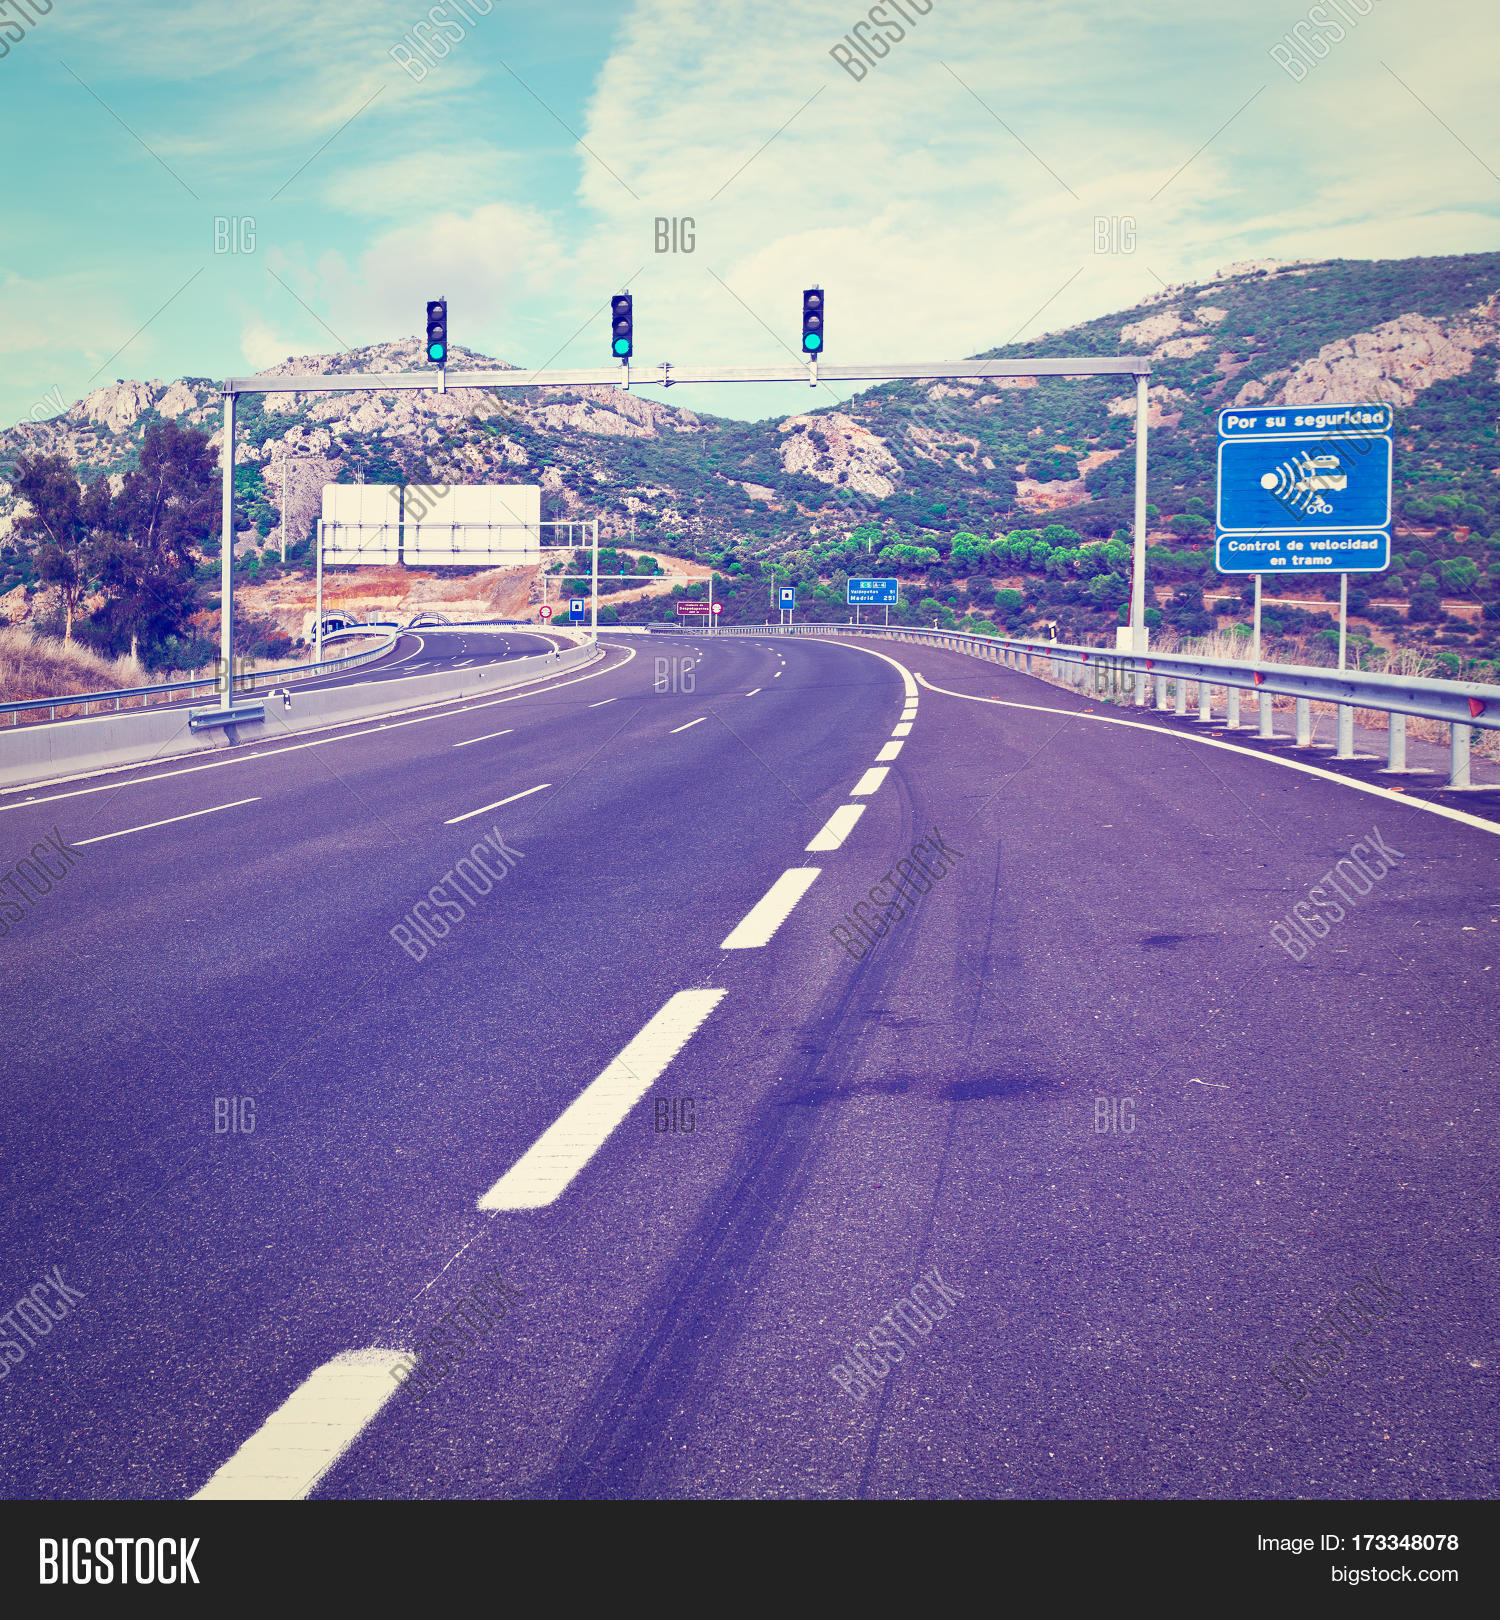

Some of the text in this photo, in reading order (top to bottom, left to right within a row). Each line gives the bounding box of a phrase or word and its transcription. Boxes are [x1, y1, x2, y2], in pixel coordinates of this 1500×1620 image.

[1227, 411, 1384, 429] Por su seguridad
[1228, 539, 1379, 551] Control de velocidad
[1270, 555, 1332, 566] en tramo
